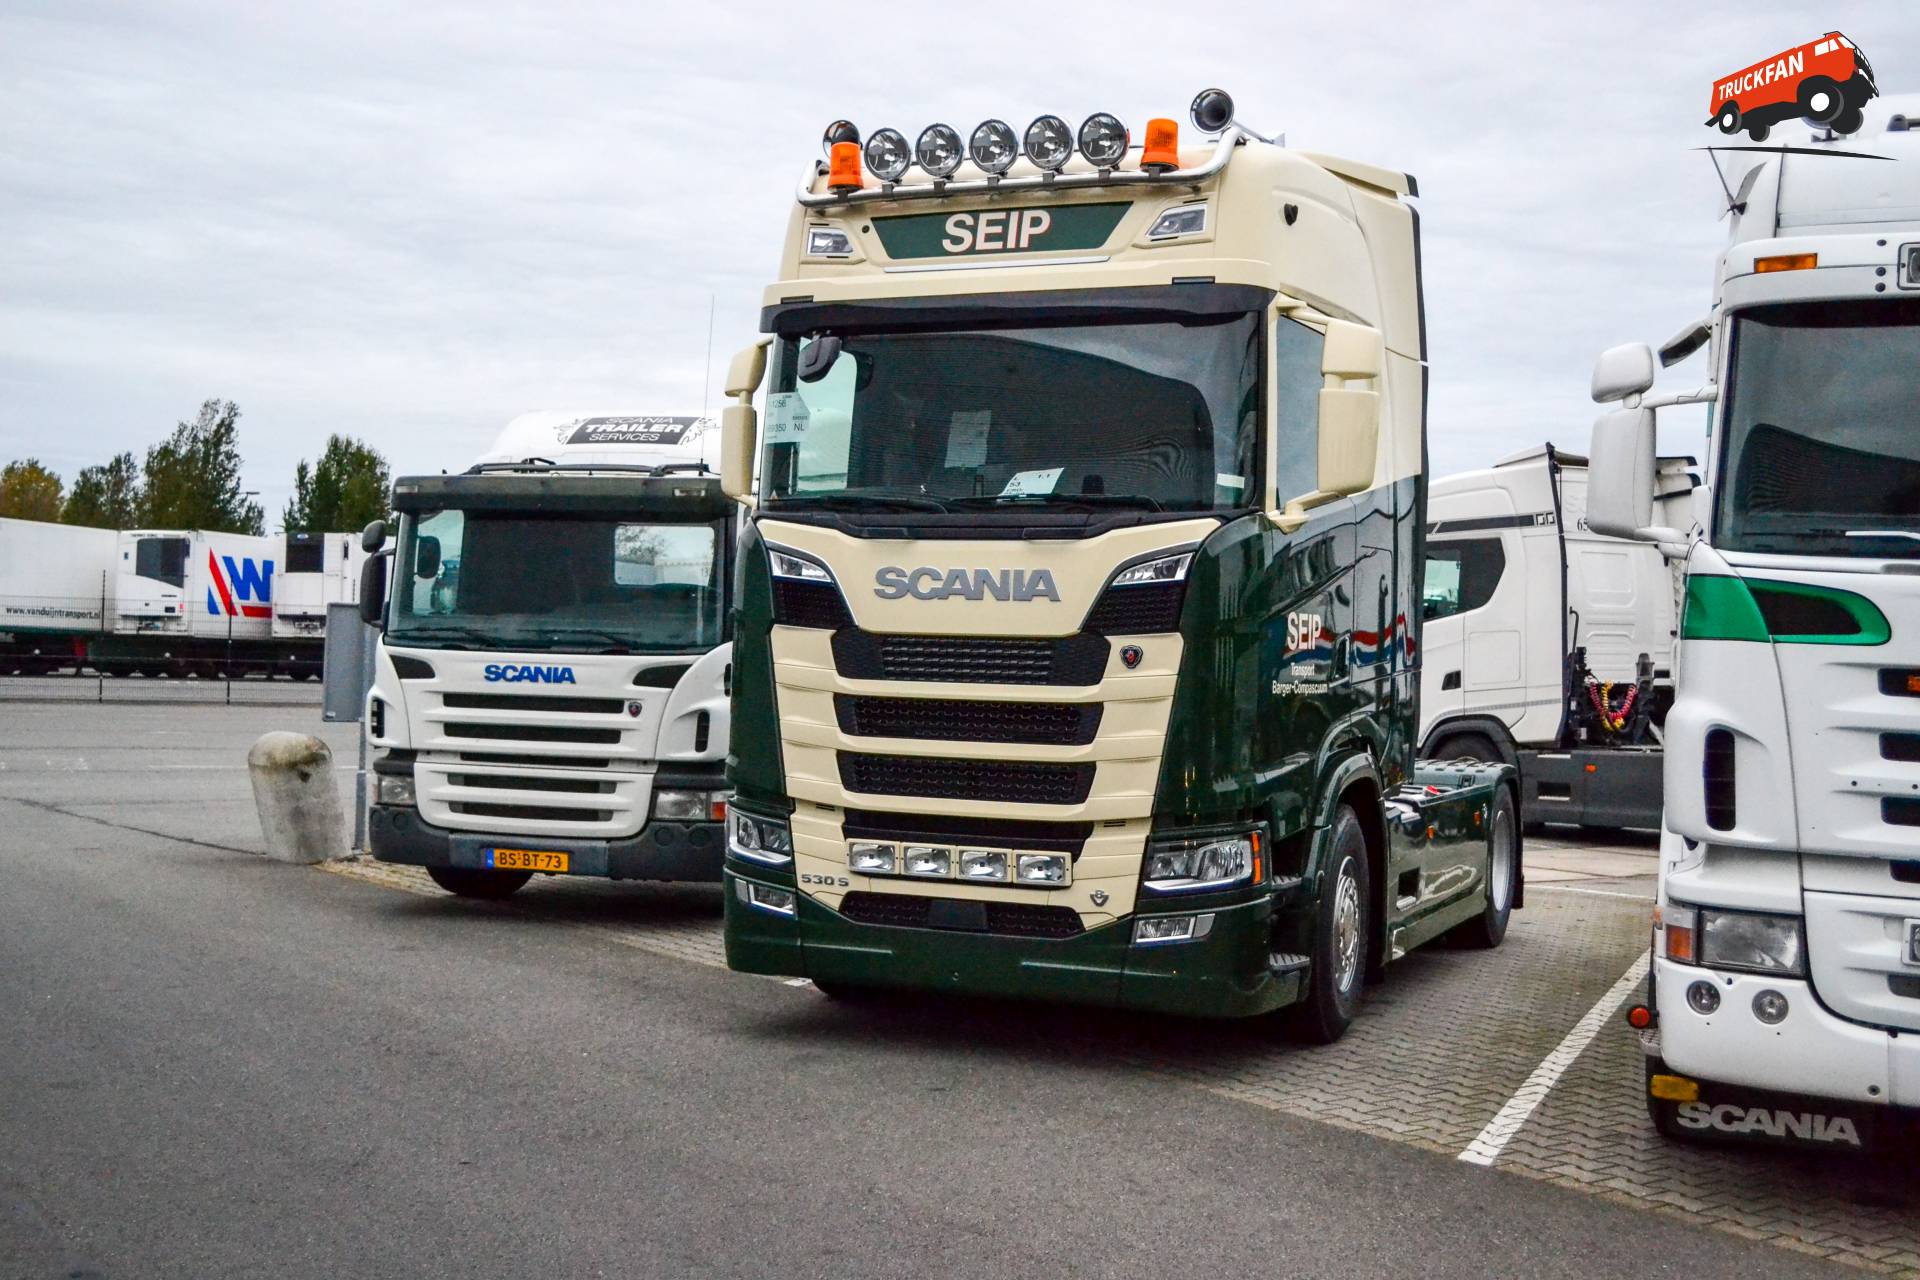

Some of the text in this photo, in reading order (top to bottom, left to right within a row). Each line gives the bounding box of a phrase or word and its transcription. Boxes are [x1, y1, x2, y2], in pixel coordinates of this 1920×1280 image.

[942, 209, 1051, 253] SEIP
[585, 424, 683, 433] TRAILER
[589, 432, 660, 441] SERVICES
[874, 566, 1062, 601] SCANIA
[1287, 611, 1321, 650] SEIP
[484, 664, 576, 684] SCANIA
[1291, 662, 1315, 678] Transport
[1272, 680, 1328, 696] Barger-Compascuum
[801, 874, 849, 887] 530 S
[1676, 1102, 1862, 1146] SCANIA
